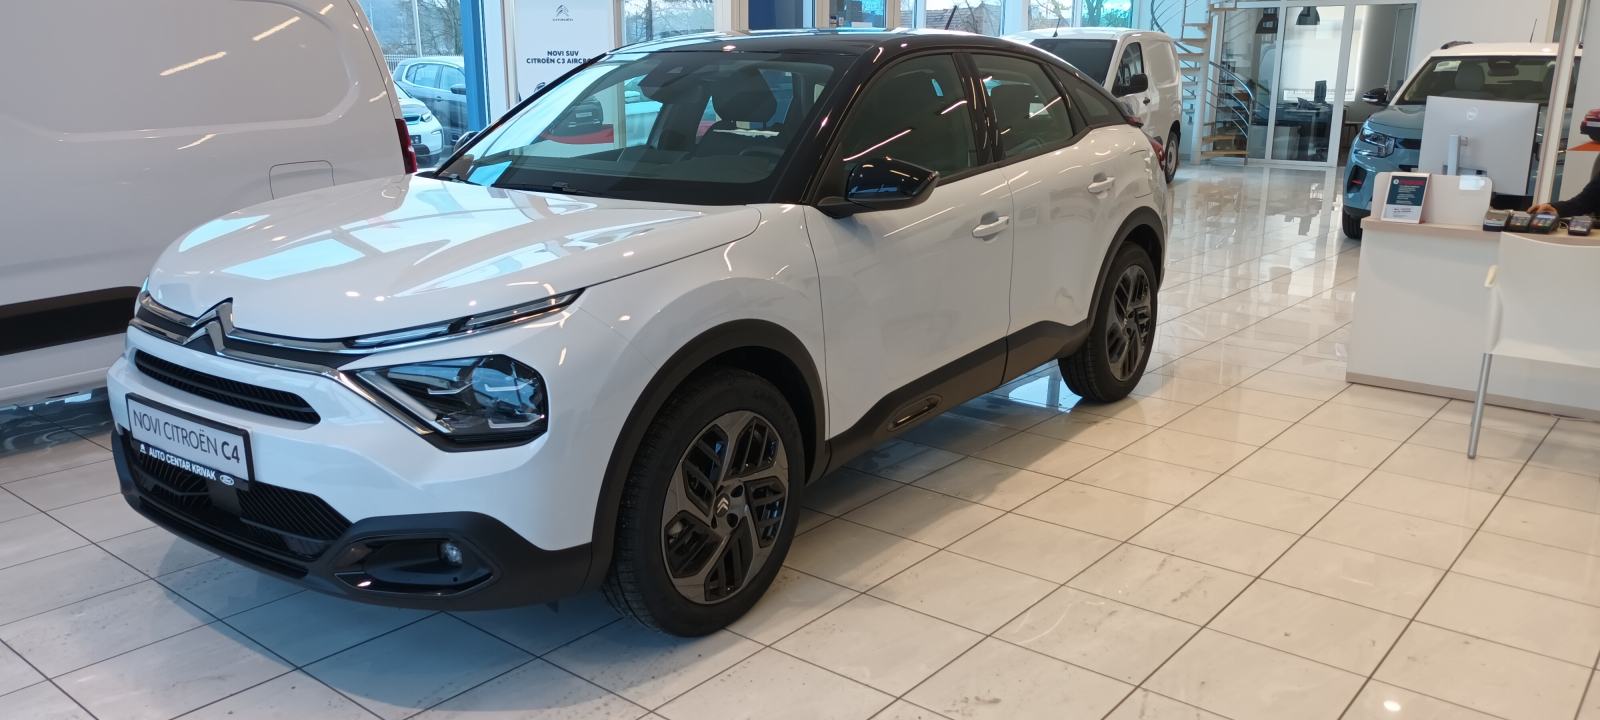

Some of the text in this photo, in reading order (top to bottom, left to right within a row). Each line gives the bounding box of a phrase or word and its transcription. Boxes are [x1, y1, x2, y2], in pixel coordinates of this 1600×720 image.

[133, 409, 241, 464] NOVI CITROËN C4
[149, 446, 217, 481] AUTO CENTAR KRIVAK
